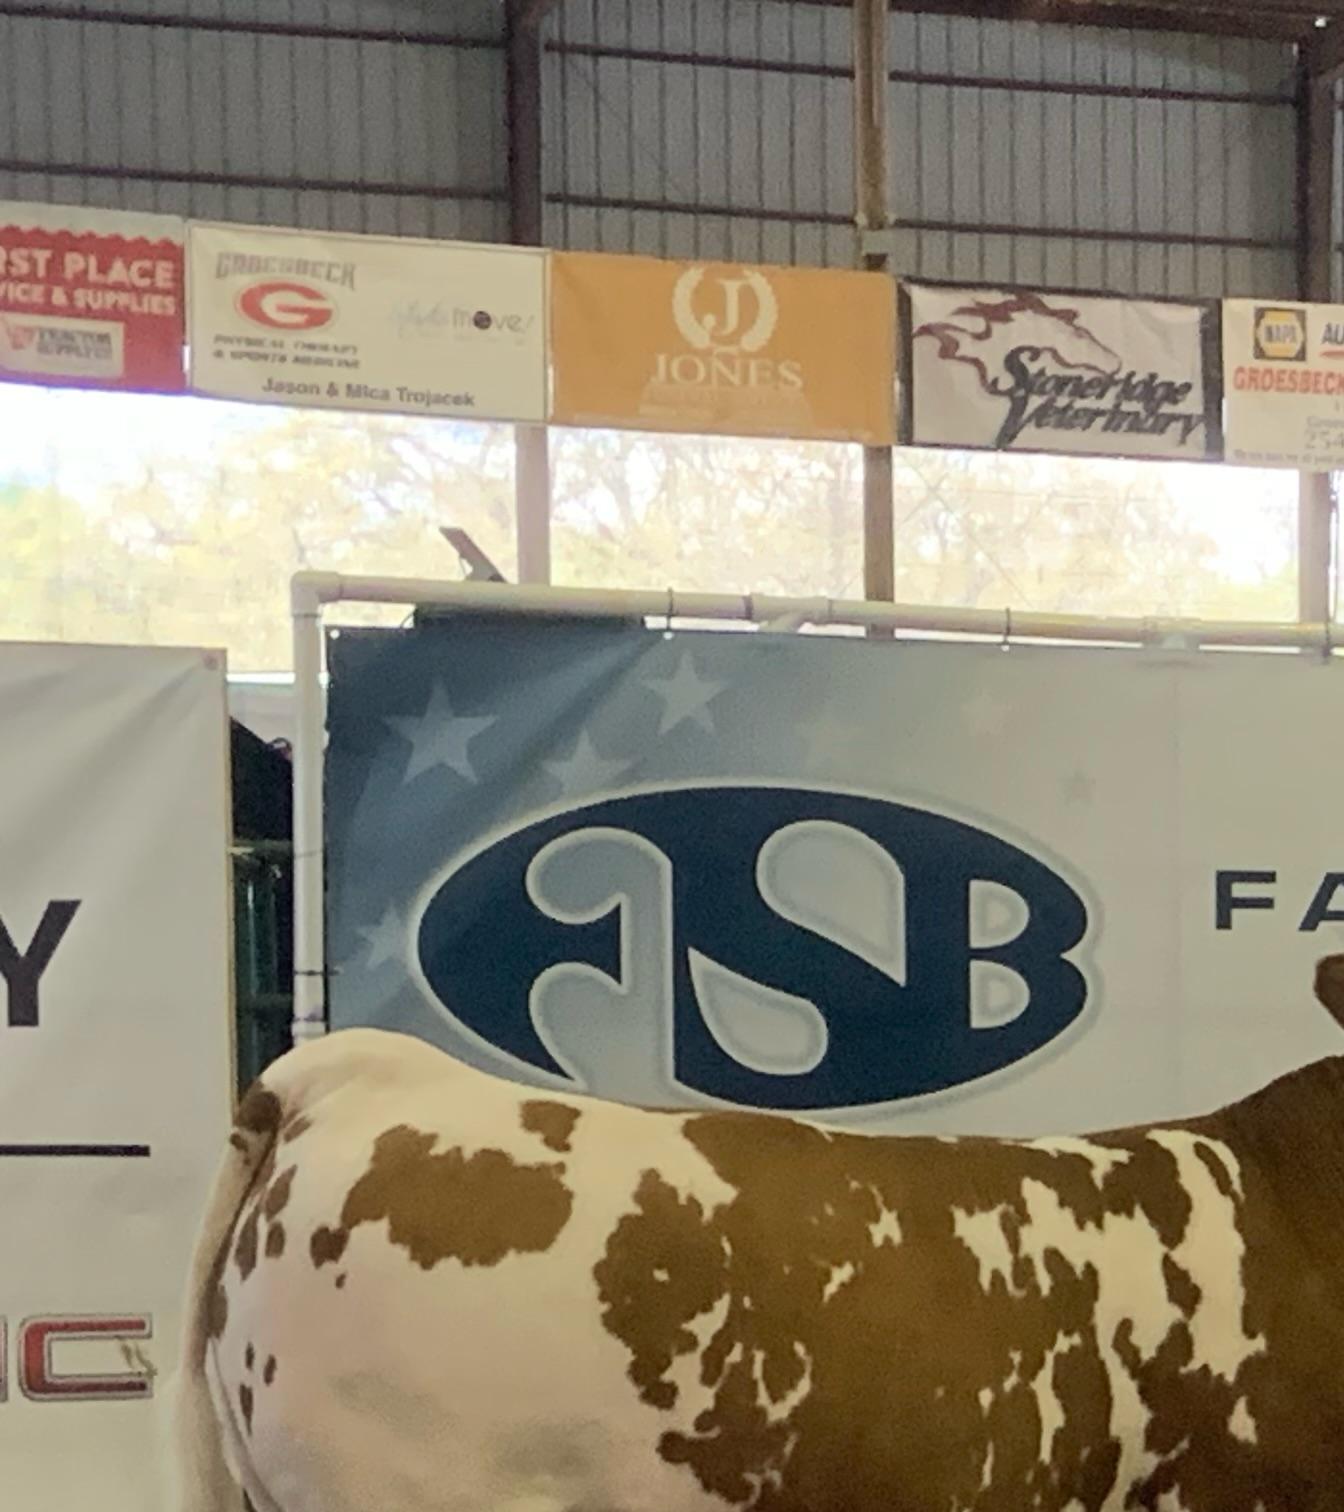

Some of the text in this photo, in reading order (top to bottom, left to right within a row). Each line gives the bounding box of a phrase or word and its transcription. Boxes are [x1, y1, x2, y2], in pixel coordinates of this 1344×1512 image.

[63, 251, 174, 288] PLACE
[73, 287, 176, 316] SUPPLIES
[240, 282, 333, 331] G
[650, 352, 802, 389] JONES
[262, 377, 475, 408] Jason & Mica Trojacek
